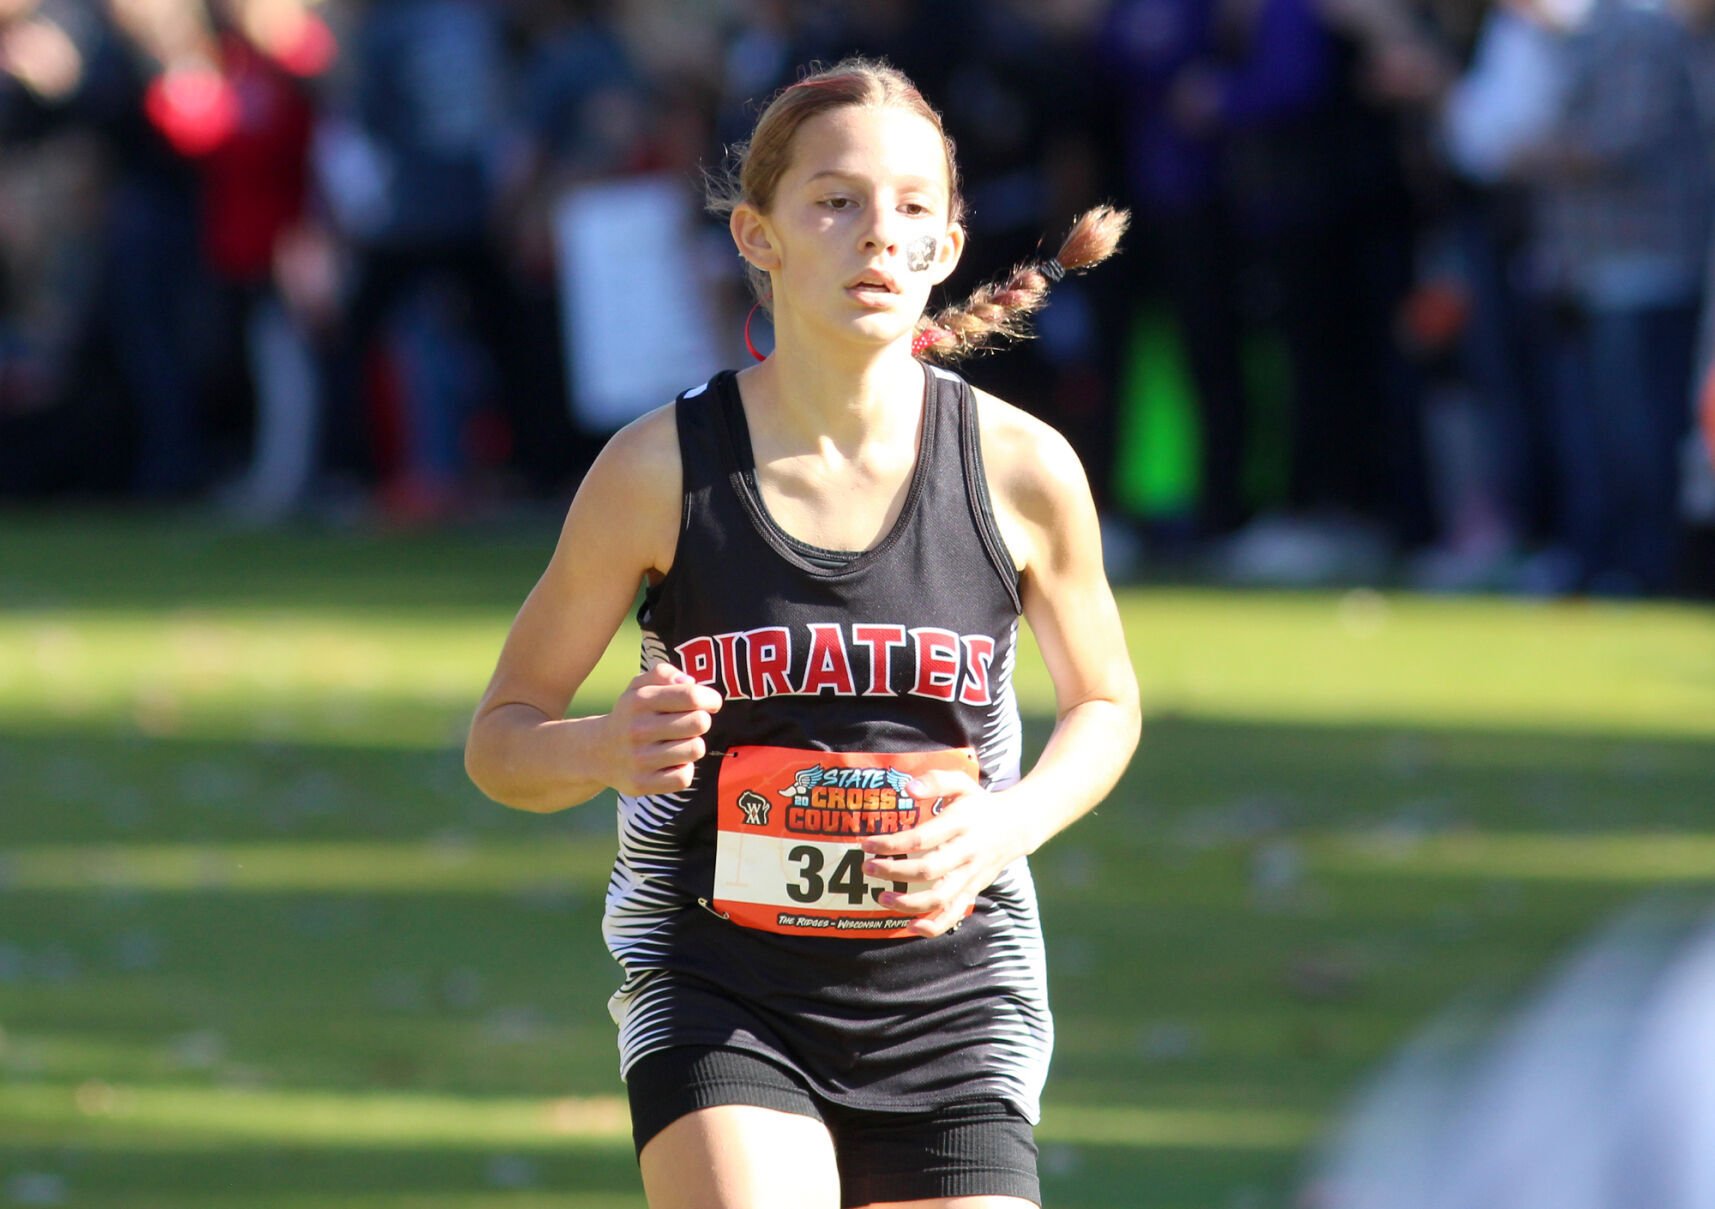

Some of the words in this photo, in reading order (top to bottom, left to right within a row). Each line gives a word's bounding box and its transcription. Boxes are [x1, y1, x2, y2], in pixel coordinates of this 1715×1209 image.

[674, 623, 995, 706] PIRATES
[822, 769, 886, 788] STATE
[811, 788, 897, 810] CROSS
[788, 807, 917, 833] COUNTRY
[778, 915, 795, 925] THE
[796, 917, 829, 928] RIDGES
[837, 919, 882, 929] WISCONSIN
